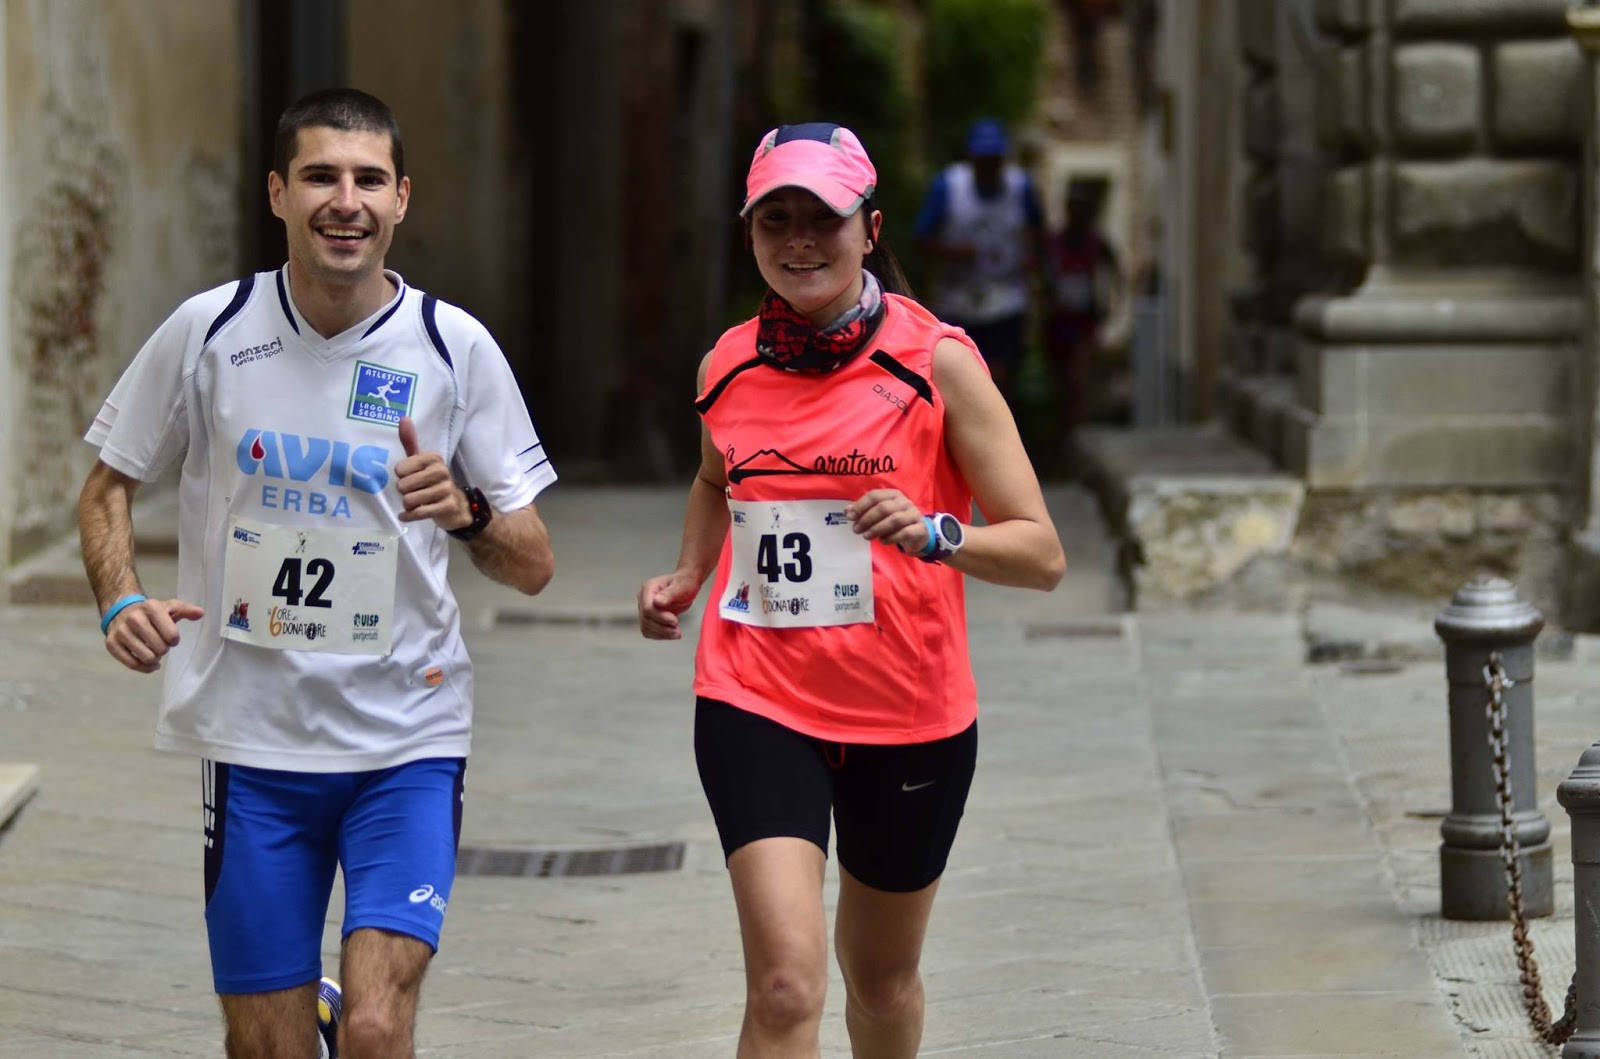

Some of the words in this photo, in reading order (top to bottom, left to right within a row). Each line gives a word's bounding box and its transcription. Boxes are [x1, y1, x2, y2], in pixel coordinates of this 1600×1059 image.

[230, 336, 282, 365] panzeri
[264, 346, 284, 358] sport
[365, 368, 407, 384] ATLETICA
[359, 402, 383, 412] LAGO
[872, 383, 908, 411] DIADO
[358, 408, 400, 422] SEGRINO
[236, 428, 390, 495] AVIS
[261, 484, 352, 518] ERBA
[757, 532, 812, 583] 43
[272, 558, 335, 608] 42
[841, 584, 860, 597] UISP
[269, 606, 282, 637] 6
[361, 614, 380, 627] UISP
